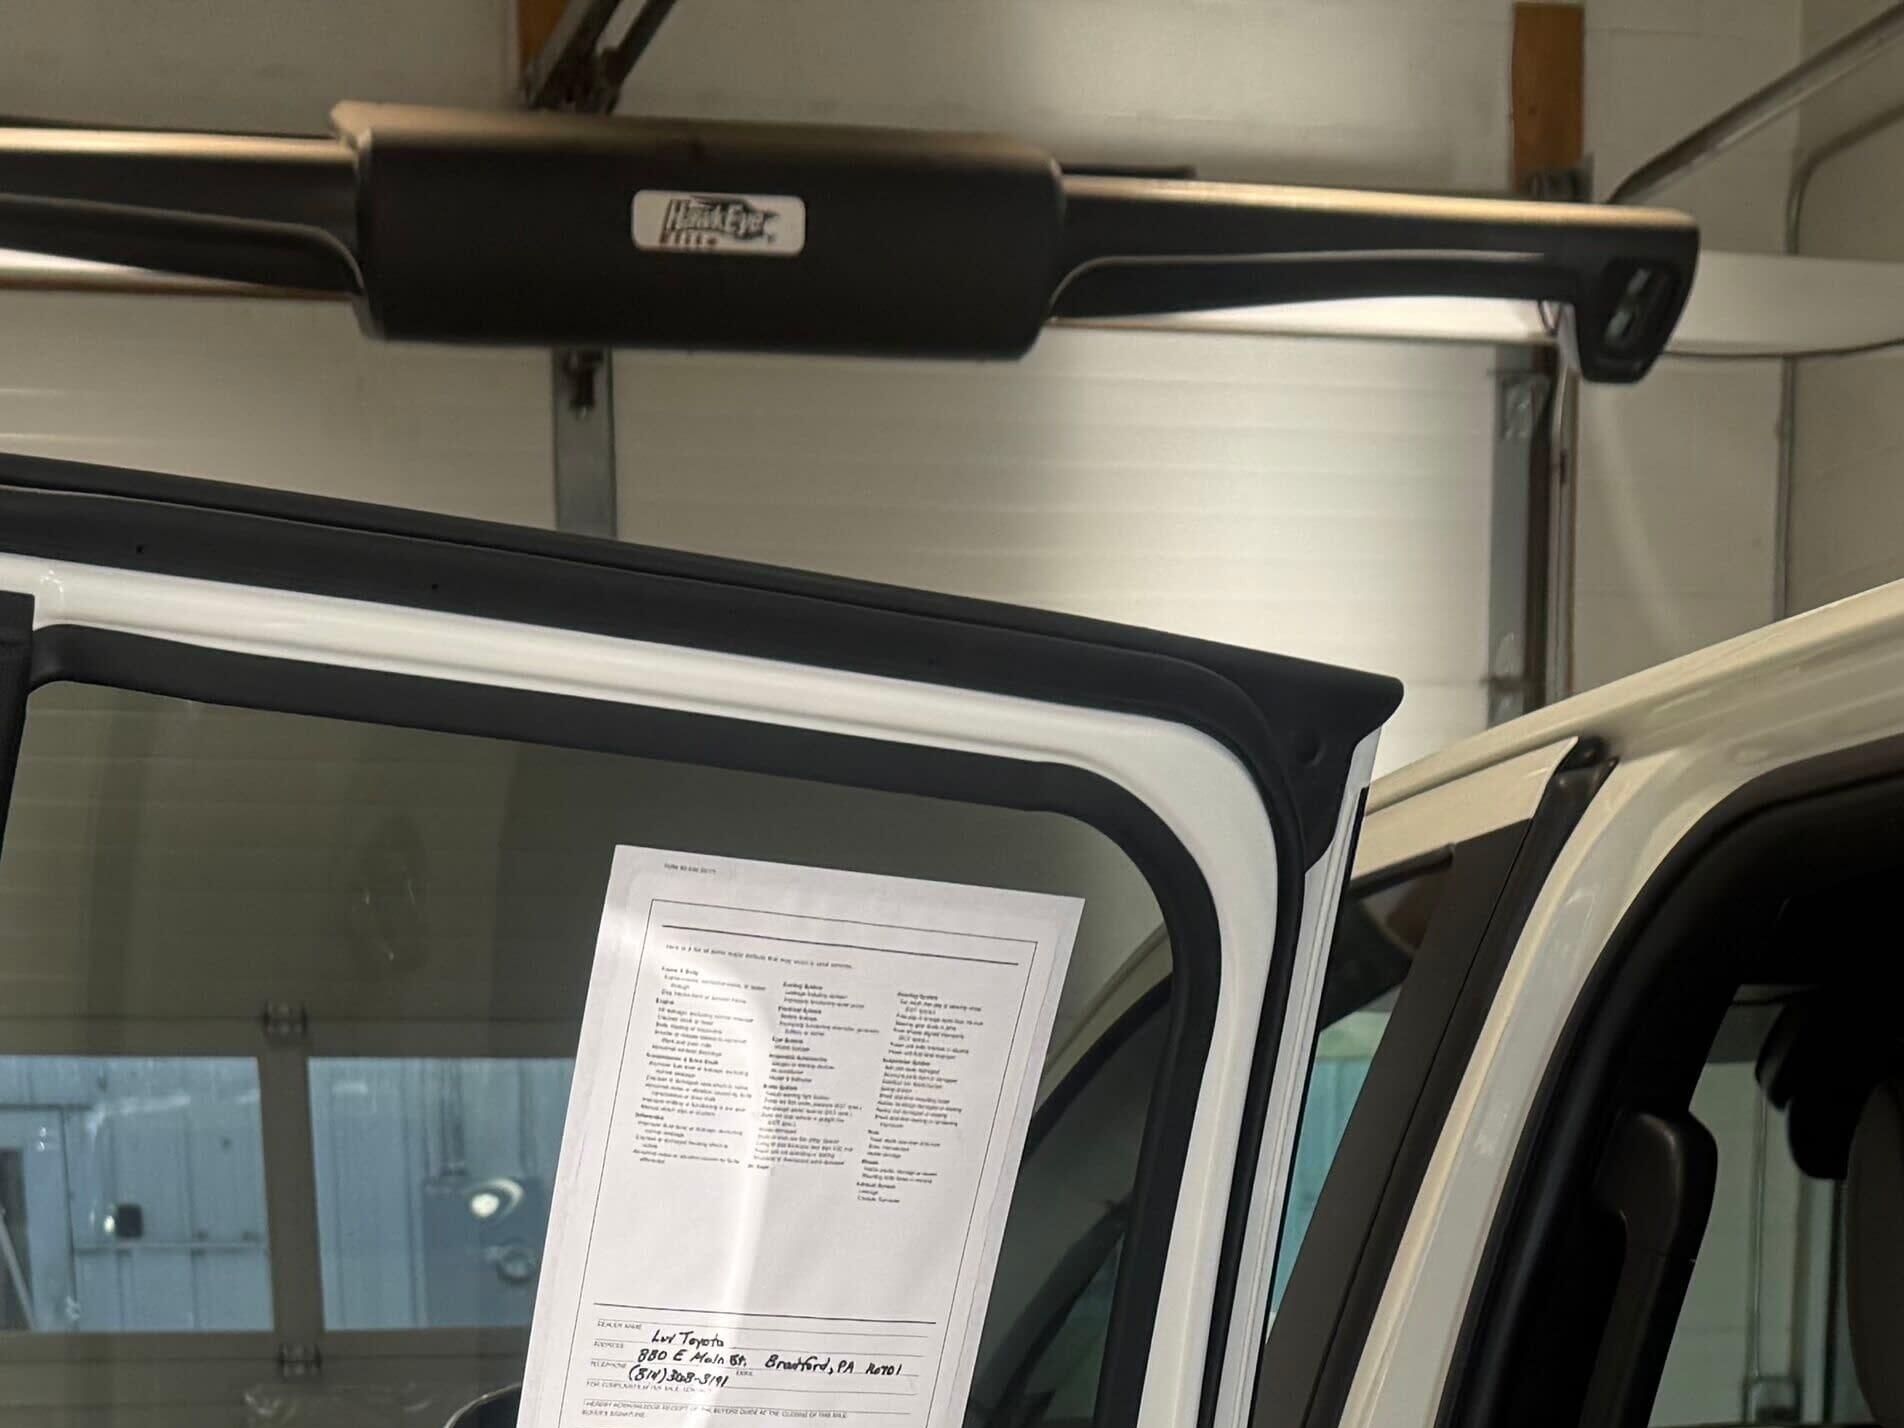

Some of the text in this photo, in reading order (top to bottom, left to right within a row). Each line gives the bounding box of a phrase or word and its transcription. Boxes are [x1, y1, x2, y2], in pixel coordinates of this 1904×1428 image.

[679, 1331, 724, 1349] Toyota
[637, 1348, 668, 1363] 880
[673, 1349, 687, 1361] E
[689, 1351, 724, 1365] Main
[837, 1360, 854, 1374] PA
